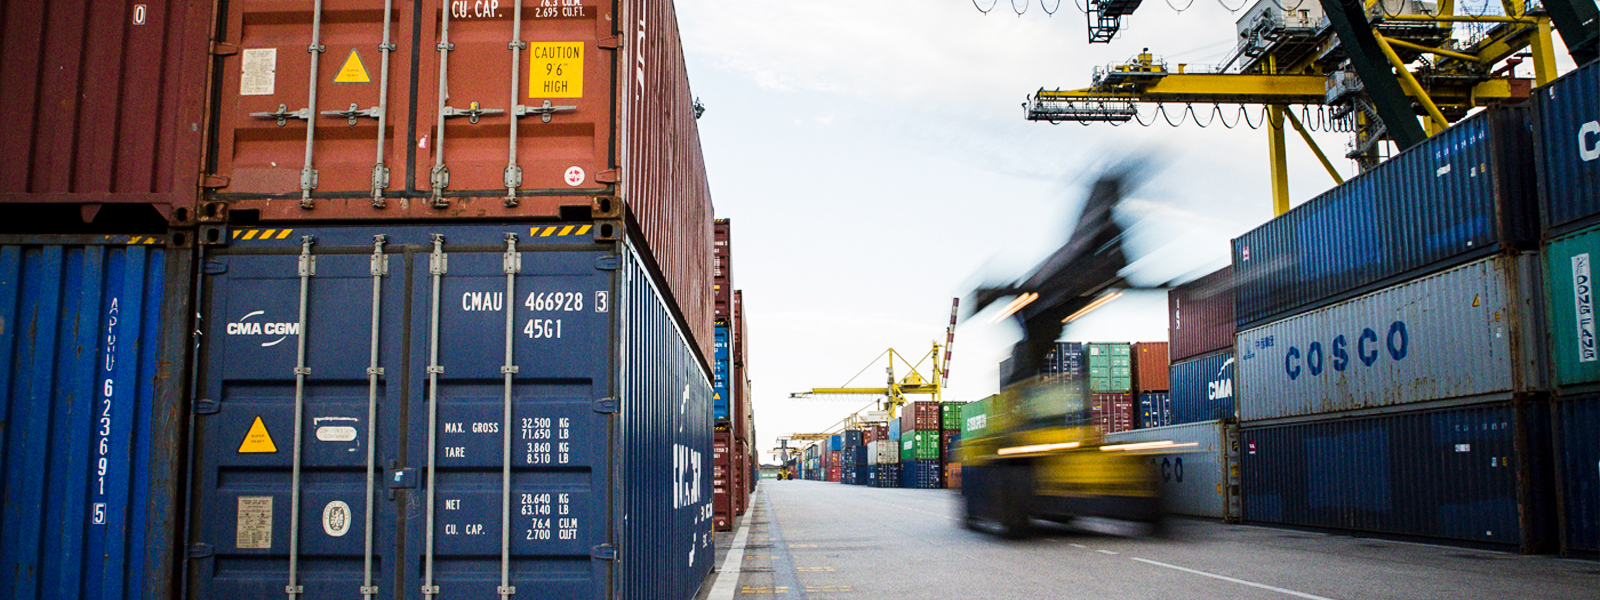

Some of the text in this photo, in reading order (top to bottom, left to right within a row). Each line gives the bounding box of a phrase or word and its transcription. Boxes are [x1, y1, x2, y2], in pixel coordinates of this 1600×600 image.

[452, 0, 502, 18] CU. CAP.
[535, 6, 585, 18] 2.695 CU.FT.
[534, 46, 580, 59] CAUTION
[543, 80, 568, 93] HIGH
[462, 291, 607, 312] CMAU 466928 3
[227, 322, 300, 335] CMA CGM
[523, 318, 562, 339] 45G1
[1285, 320, 1409, 381] COSCO
[444, 422, 499, 434] MAX. GROSS
[521, 417, 570, 428] 32.500 KG
[521, 428, 570, 440] 71.650 LB
[444, 446, 466, 458] TARE
[527, 442, 570, 453] 3.860 KG
[526, 453, 570, 464] 8.510 LB
[445, 499, 461, 511] NET
[521, 493, 570, 505] 28.640 KG
[521, 504, 569, 516] 63.140 LB
[445, 523, 486, 535] CU. CAP.
[531, 517, 551, 529] 76.4
[526, 529, 551, 540] 2.700
